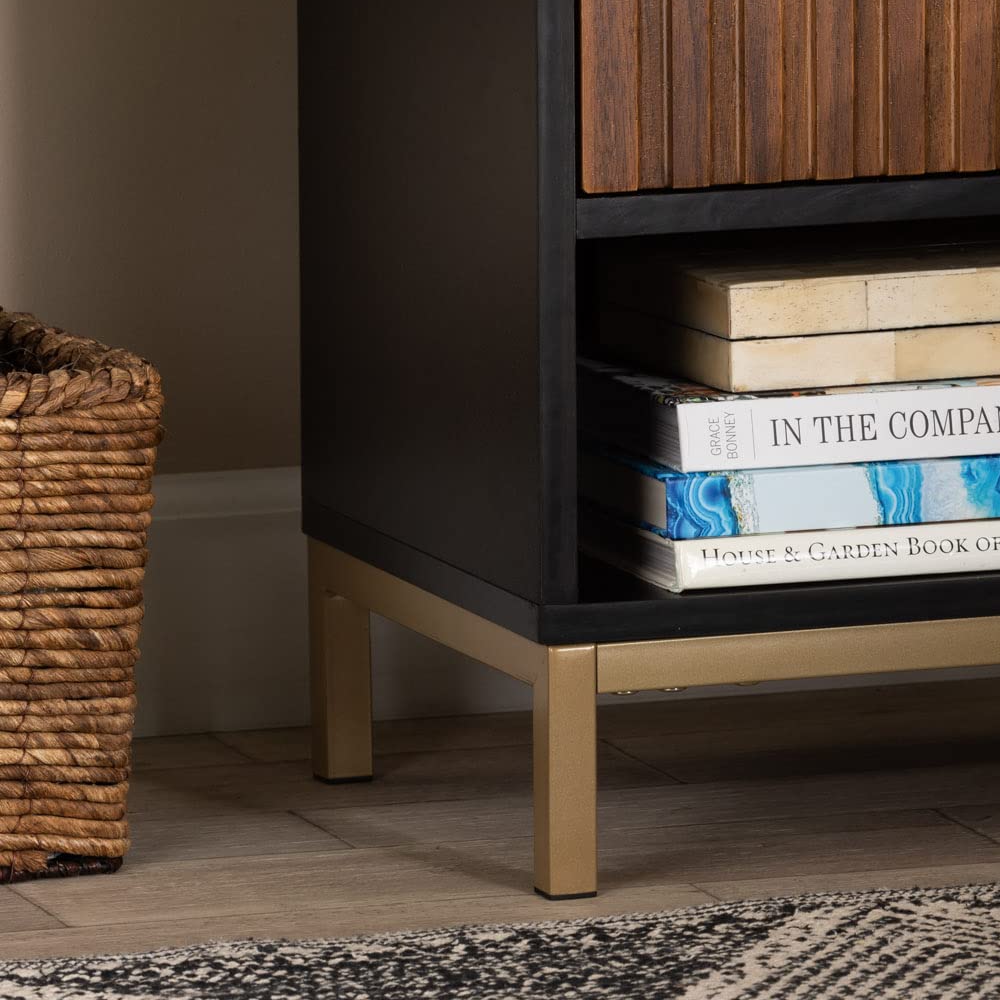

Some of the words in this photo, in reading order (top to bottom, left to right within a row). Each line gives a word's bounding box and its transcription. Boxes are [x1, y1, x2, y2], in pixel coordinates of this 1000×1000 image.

[710, 416, 722, 456] GRACE
[726, 411, 739, 459] BONNEY
[770, 417, 803, 447] IN
[813, 413, 878, 444] THE
[784, 545, 800, 562] &
